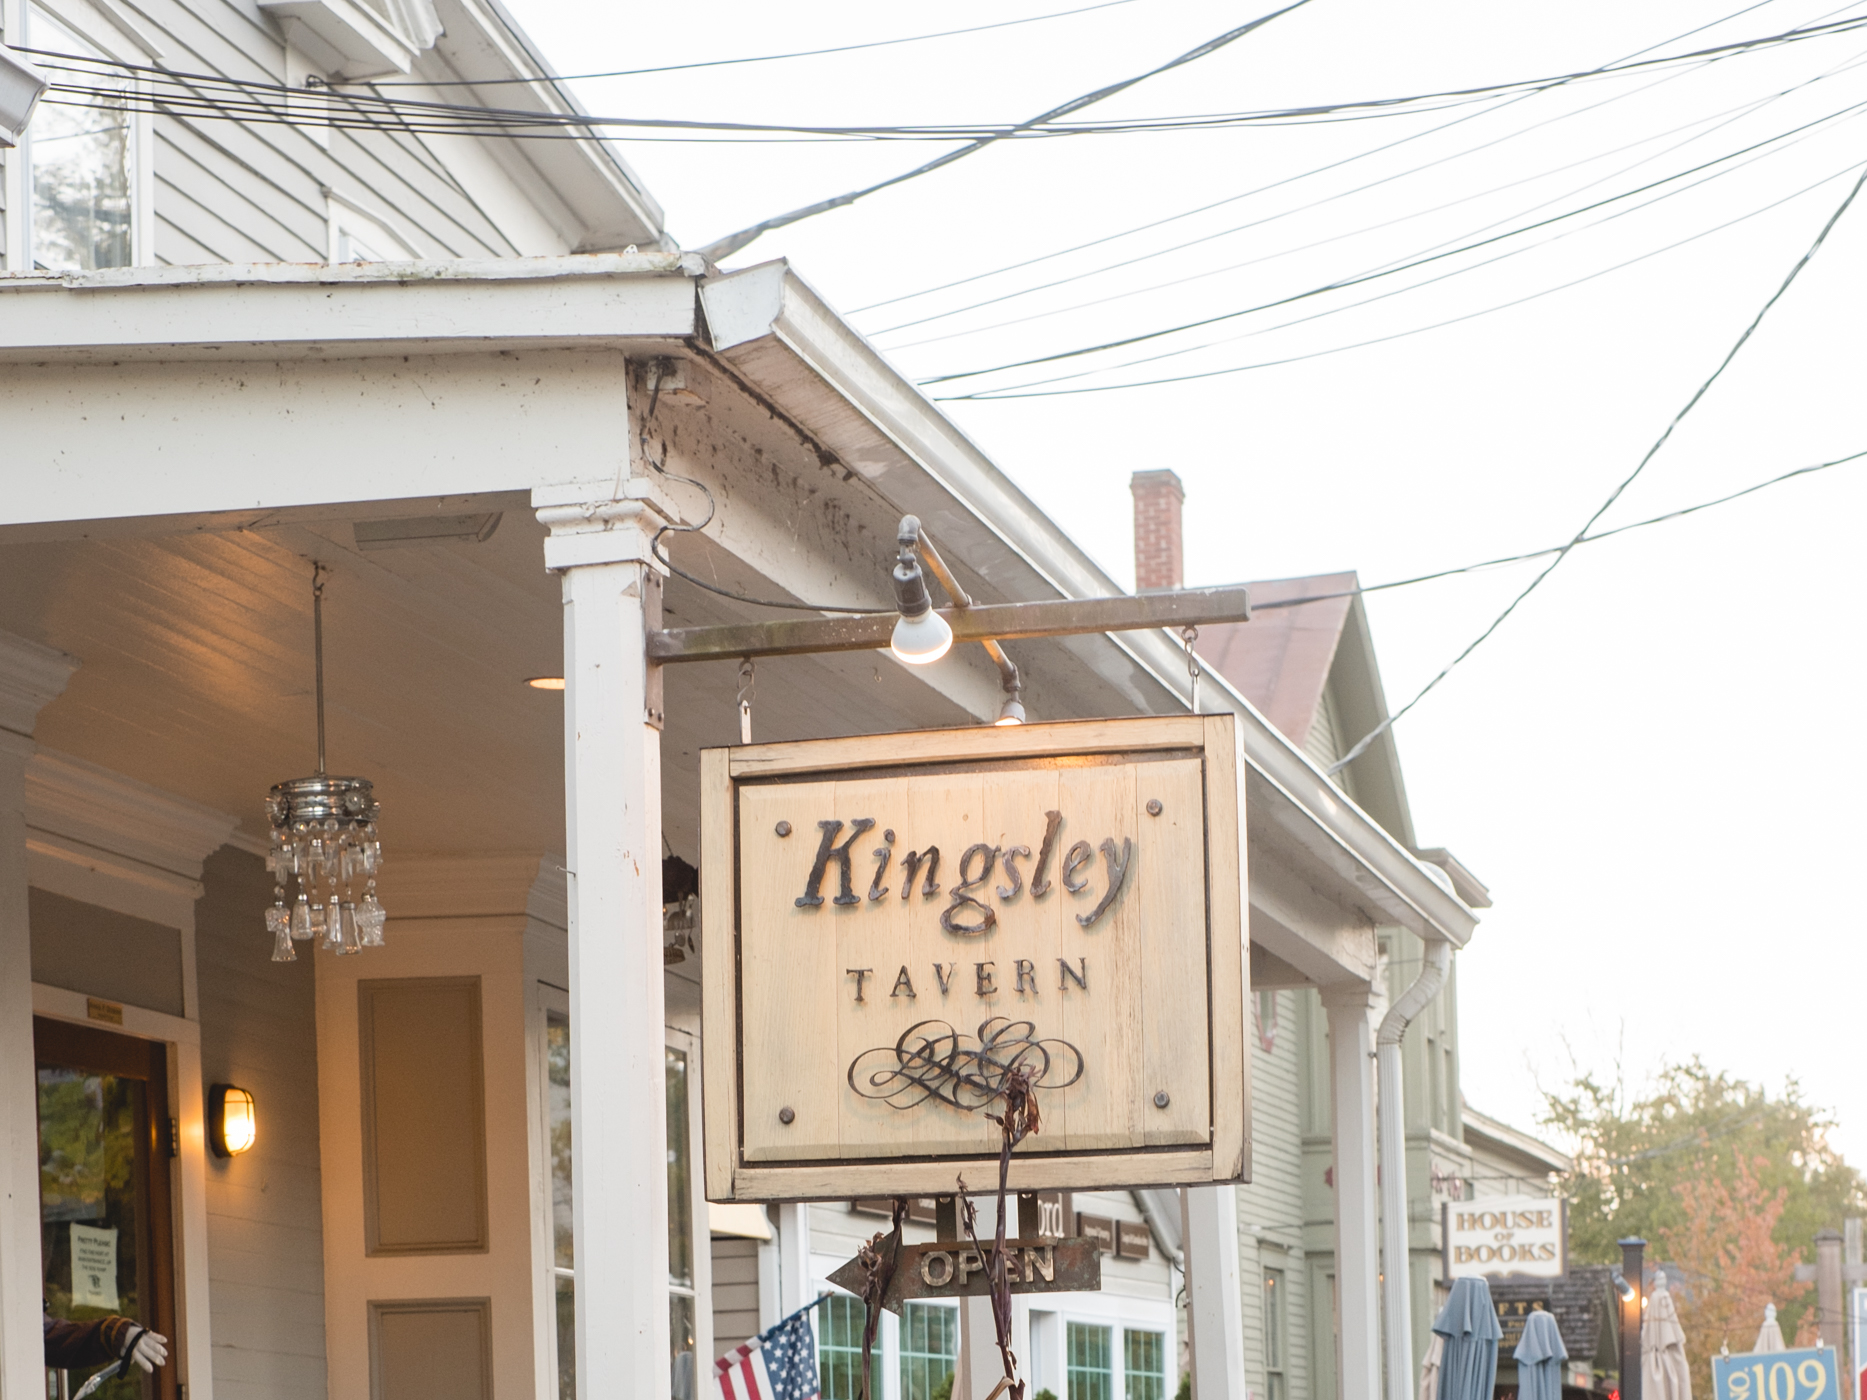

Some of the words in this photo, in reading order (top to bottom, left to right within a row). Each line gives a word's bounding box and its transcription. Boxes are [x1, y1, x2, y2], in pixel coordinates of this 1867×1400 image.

[795, 810, 1132, 935] Kingsley
[846, 957, 1088, 1002] TAVERN
[1456, 1210, 1552, 1231] HOUSE
[920, 1246, 1054, 1287] OPEN
[1454, 1243, 1555, 1264] BOOKS
